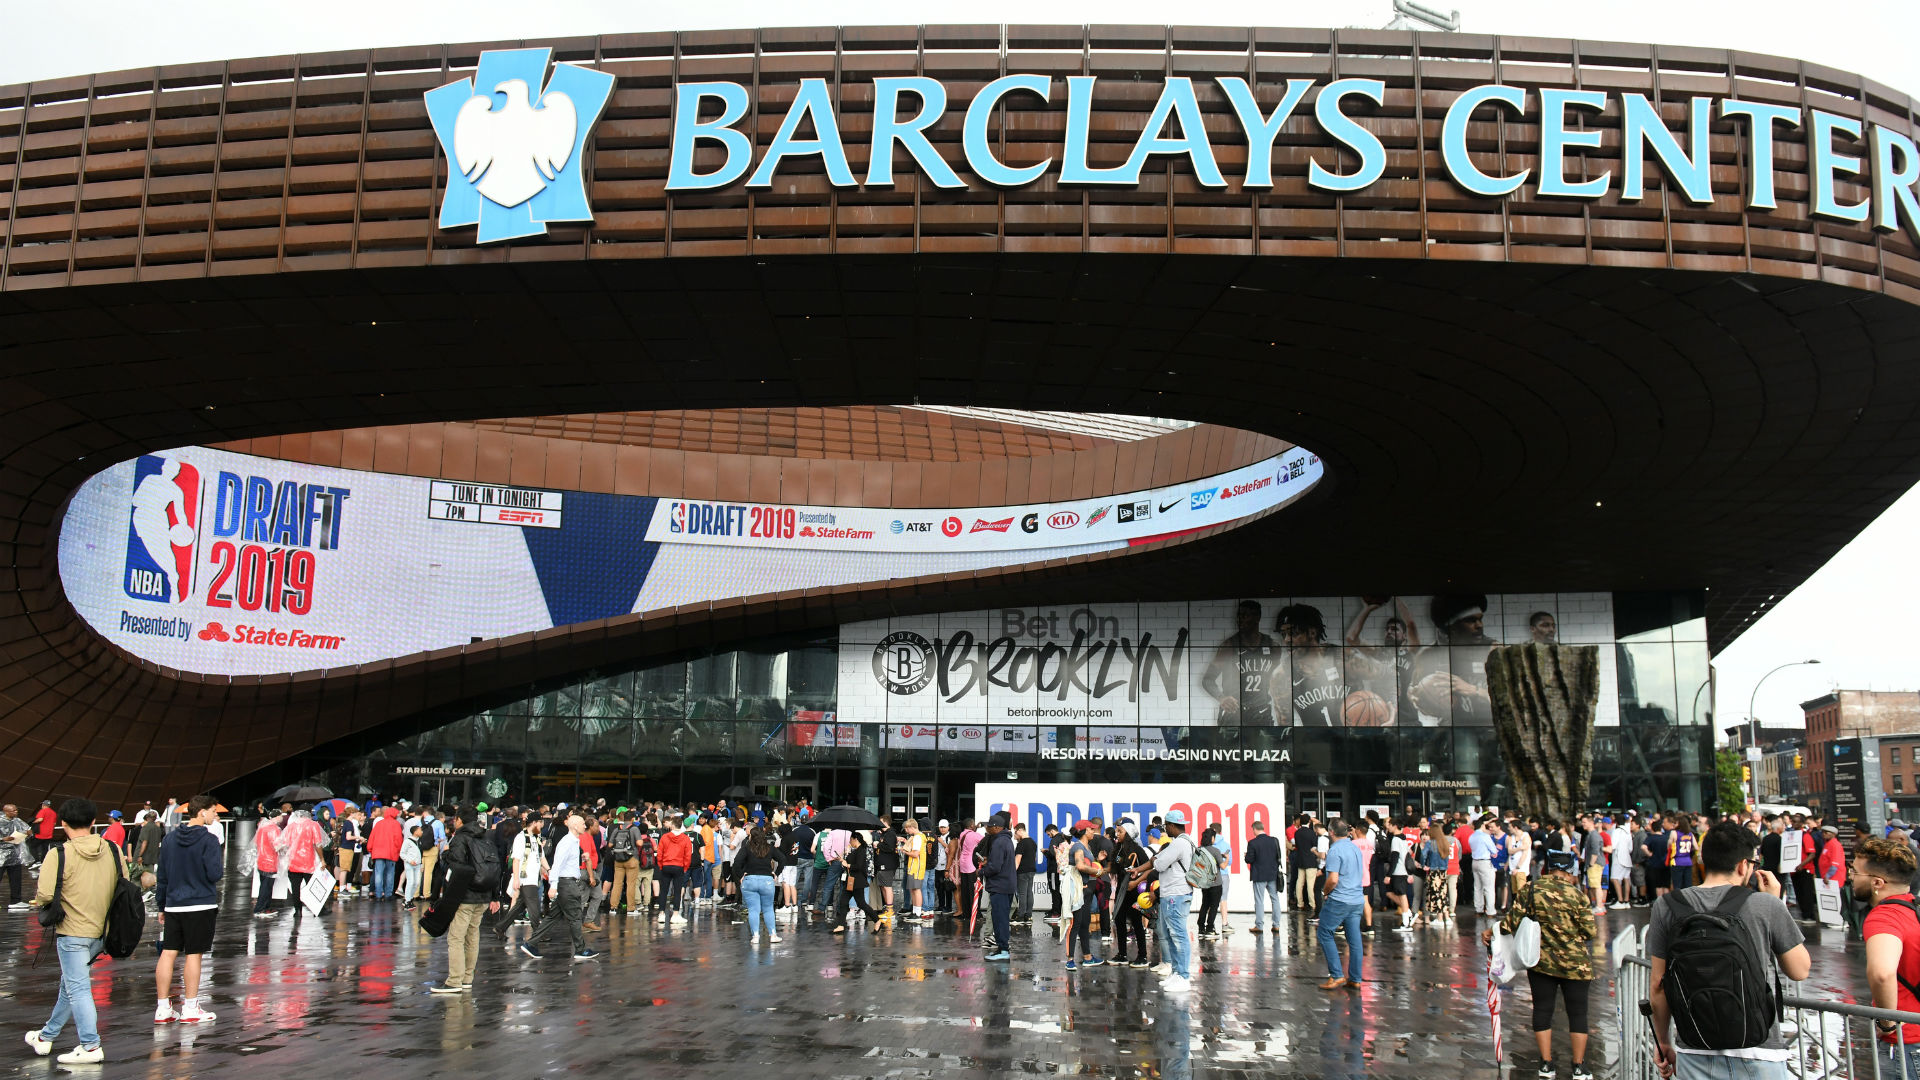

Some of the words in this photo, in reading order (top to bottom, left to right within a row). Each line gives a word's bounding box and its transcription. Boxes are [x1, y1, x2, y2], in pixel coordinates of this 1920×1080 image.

[665, 73, 1388, 193] BARCLAYS
[1441, 84, 1920, 243] CENTER
[1289, 457, 1304, 470] TACO
[1290, 467, 1305, 480] BELL
[452, 485, 479, 503] TUNE
[482, 487, 493, 504] IN
[498, 488, 544, 508] TONIGHT
[1191, 493, 1212, 507] SAP
[212, 470, 351, 551] DRAFT
[445, 503, 466, 519] 7PM
[498, 509, 544, 524] ESPN
[799, 511, 829, 524] Presented
[829, 513, 837, 526] by
[688, 503, 746, 537] DRAFT
[750, 506, 796, 539] 2019
[906, 522, 933, 532] AT&T
[974, 520, 1010, 531] Budweiser
[1052, 515, 1073, 526] KIA
[130, 569, 164, 597] NBA
[206, 541, 316, 616] 2019
[119, 610, 176, 638] Presented
[177, 618, 192, 642] by
[1001, 608, 1060, 638] Bet
[1069, 608, 1120, 640] On
[876, 633, 932, 655] BROOKLYN
[897, 647, 912, 680] B
[934, 627, 1188, 703] BROOKLYN
[878, 674, 899, 692] NEW
[904, 675, 931, 694] YORK
[1244, 674, 1262, 692] 22
[1294, 684, 1351, 709] BROOKLYN
[1007, 707, 1113, 719] betonbrooklyn.com
[1320, 706, 1333, 726] 1
[1042, 748, 1104, 760] RESORTS
[1107, 748, 1156, 761] WORLD
[1160, 748, 1210, 761] CASINO
[1212, 749, 1241, 761] NYC
[1243, 750, 1291, 762] PLAZA
[396, 766, 451, 775] STARBUCKS
[452, 768, 487, 776] COFFEE
[1384, 780, 1406, 788] GEICO
[1408, 780, 1429, 788] MAIN
[1430, 780, 1473, 788] ENTRANCE
